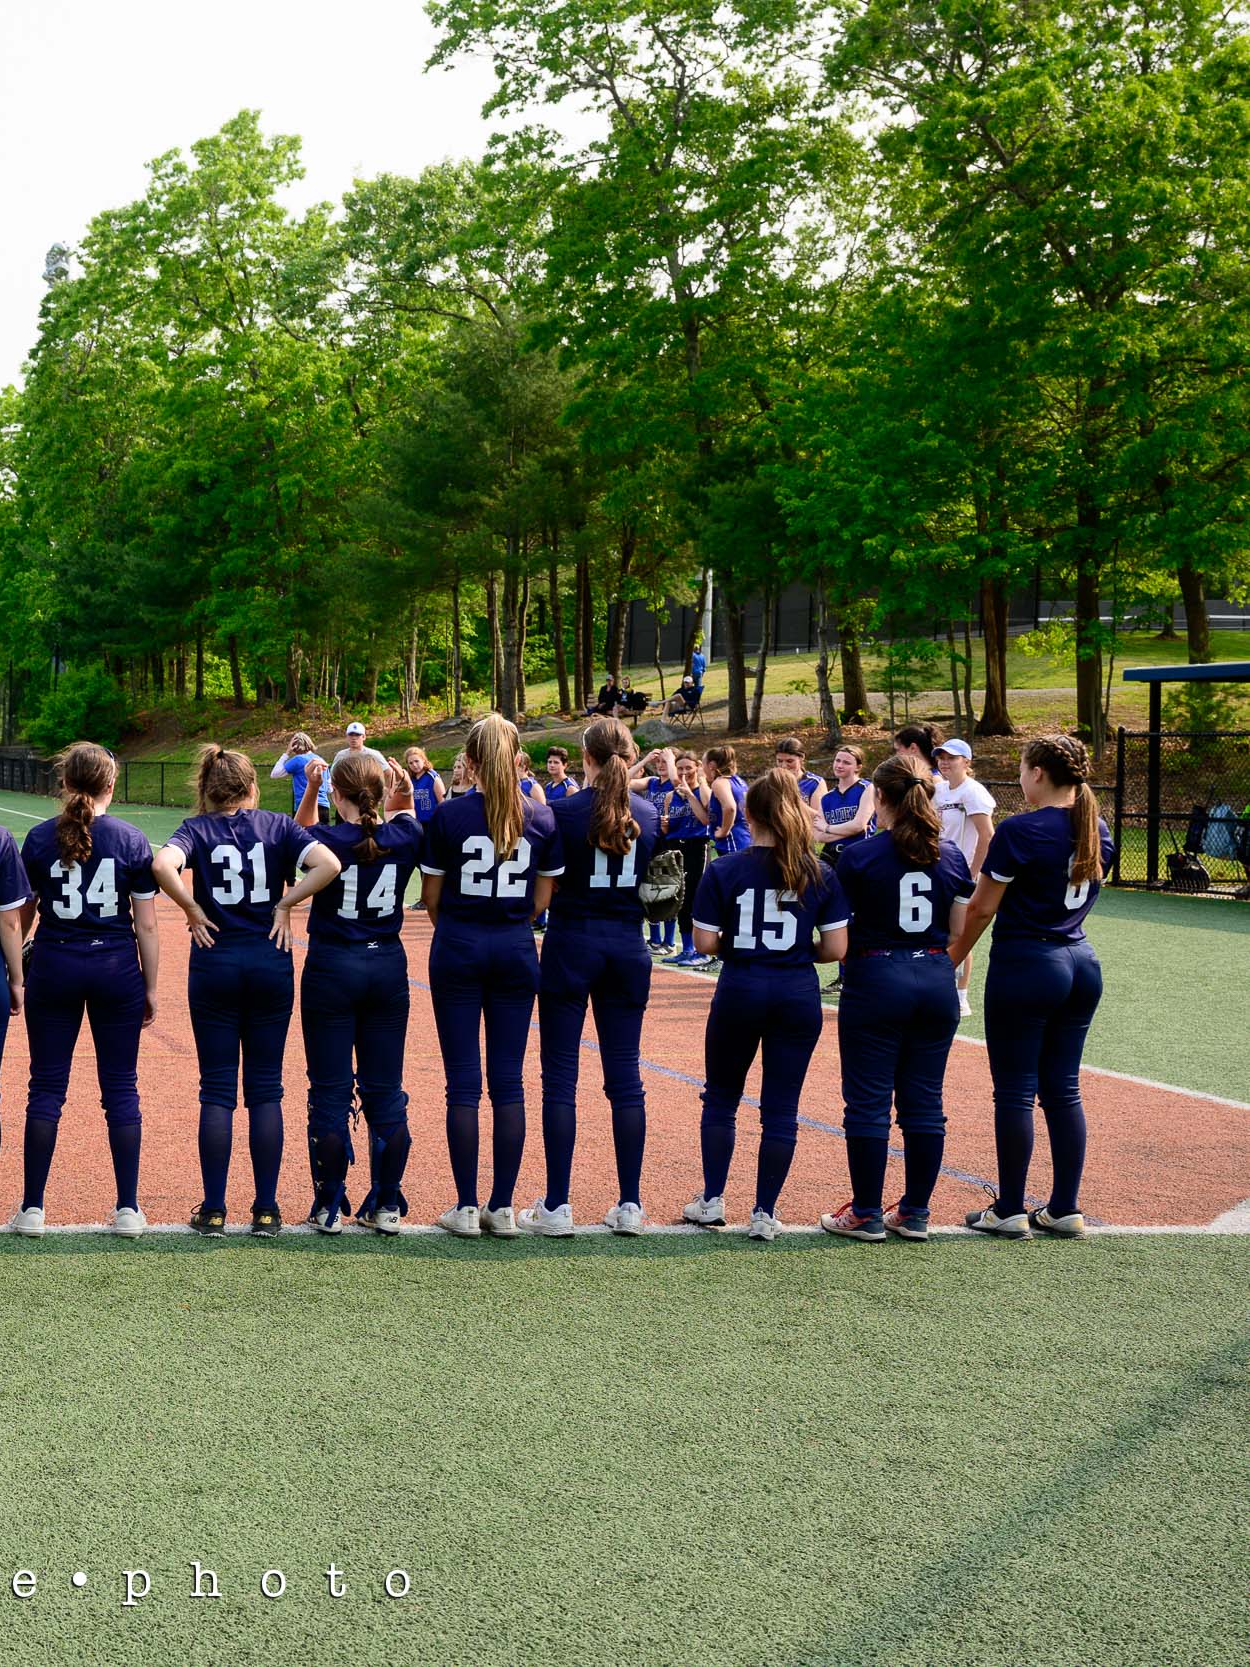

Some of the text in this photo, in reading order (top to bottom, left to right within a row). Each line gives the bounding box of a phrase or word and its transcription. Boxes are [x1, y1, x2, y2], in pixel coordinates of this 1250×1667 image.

[50, 857, 119, 920] 34
[211, 842, 270, 905] 31
[337, 864, 397, 919] 14
[461, 835, 532, 898] 22
[590, 839, 638, 888] 11
[733, 888, 798, 951] 15
[898, 871, 933, 933] 6
